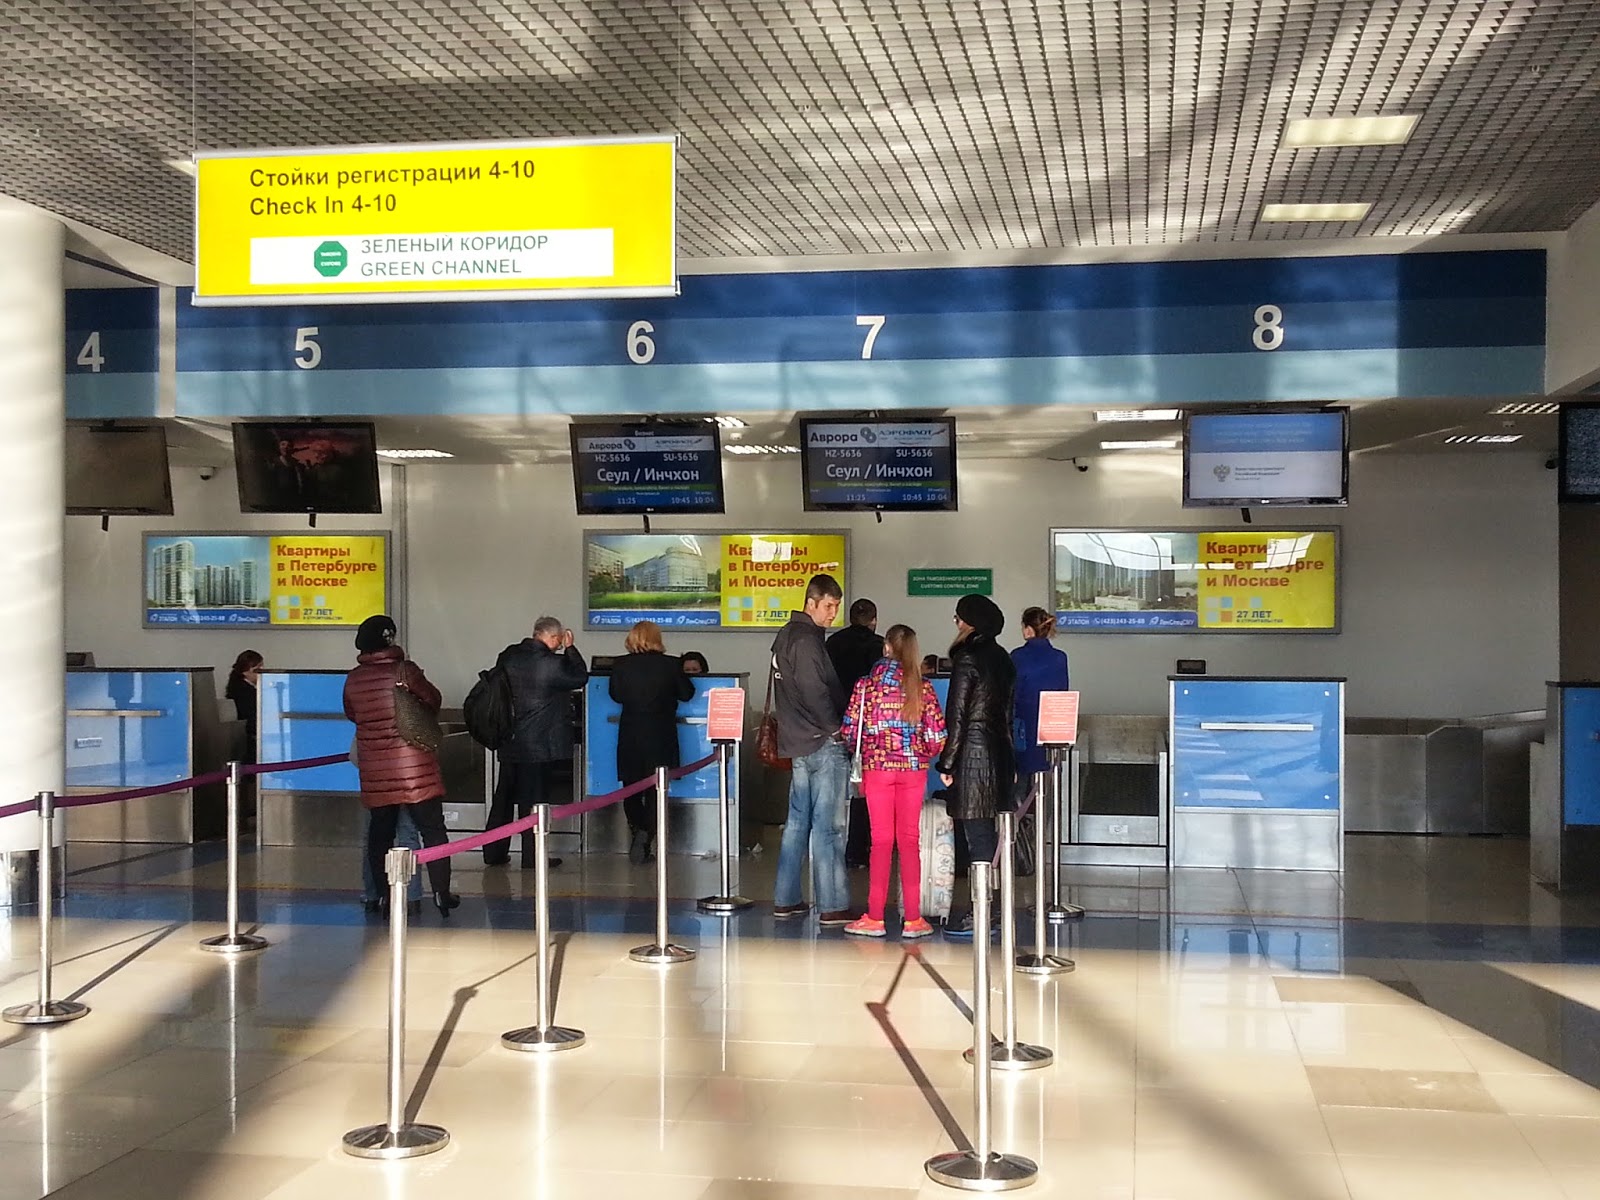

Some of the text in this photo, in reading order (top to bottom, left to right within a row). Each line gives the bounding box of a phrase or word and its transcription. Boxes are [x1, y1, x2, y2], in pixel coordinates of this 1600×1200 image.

[250, 160, 535, 189] Стойки регистрации 4-10
[250, 194, 396, 215] Check In 4-10
[361, 235, 548, 253] ЗЕЛЕНЫЙ КОРИДОР
[361, 259, 522, 276] GREEN CHANNEL
[1252, 304, 1284, 350] 8
[626, 320, 656, 364] 6
[856, 315, 886, 359] 7
[77, 331, 105, 373] 4
[294, 327, 322, 369] 5
[810, 432, 858, 444] Аврора
[589, 442, 622, 451] Аврора
[825, 449, 862, 457] HZ-5636
[896, 449, 933, 457] SU-5636
[595, 454, 631, 462] HZ-5636
[663, 452, 699, 461] SU-5636
[597, 468, 700, 484] Сеул / Инчхон
[826, 464, 933, 480] Сеул / Инчхон
[277, 545, 350, 559] Квартиры
[1206, 542, 1268, 556] Кварти
[277, 560, 377, 574] в Петербурге
[728, 562, 737, 572] в
[277, 575, 348, 587] и Москве
[728, 576, 805, 588] и Москве
[1206, 575, 1290, 587] и Москве
[303, 608, 334, 616] 27 ЛЕТ
[756, 610, 789, 618] 27 ЛЕТ
[1237, 610, 1272, 618] 27 ЛЕТ
